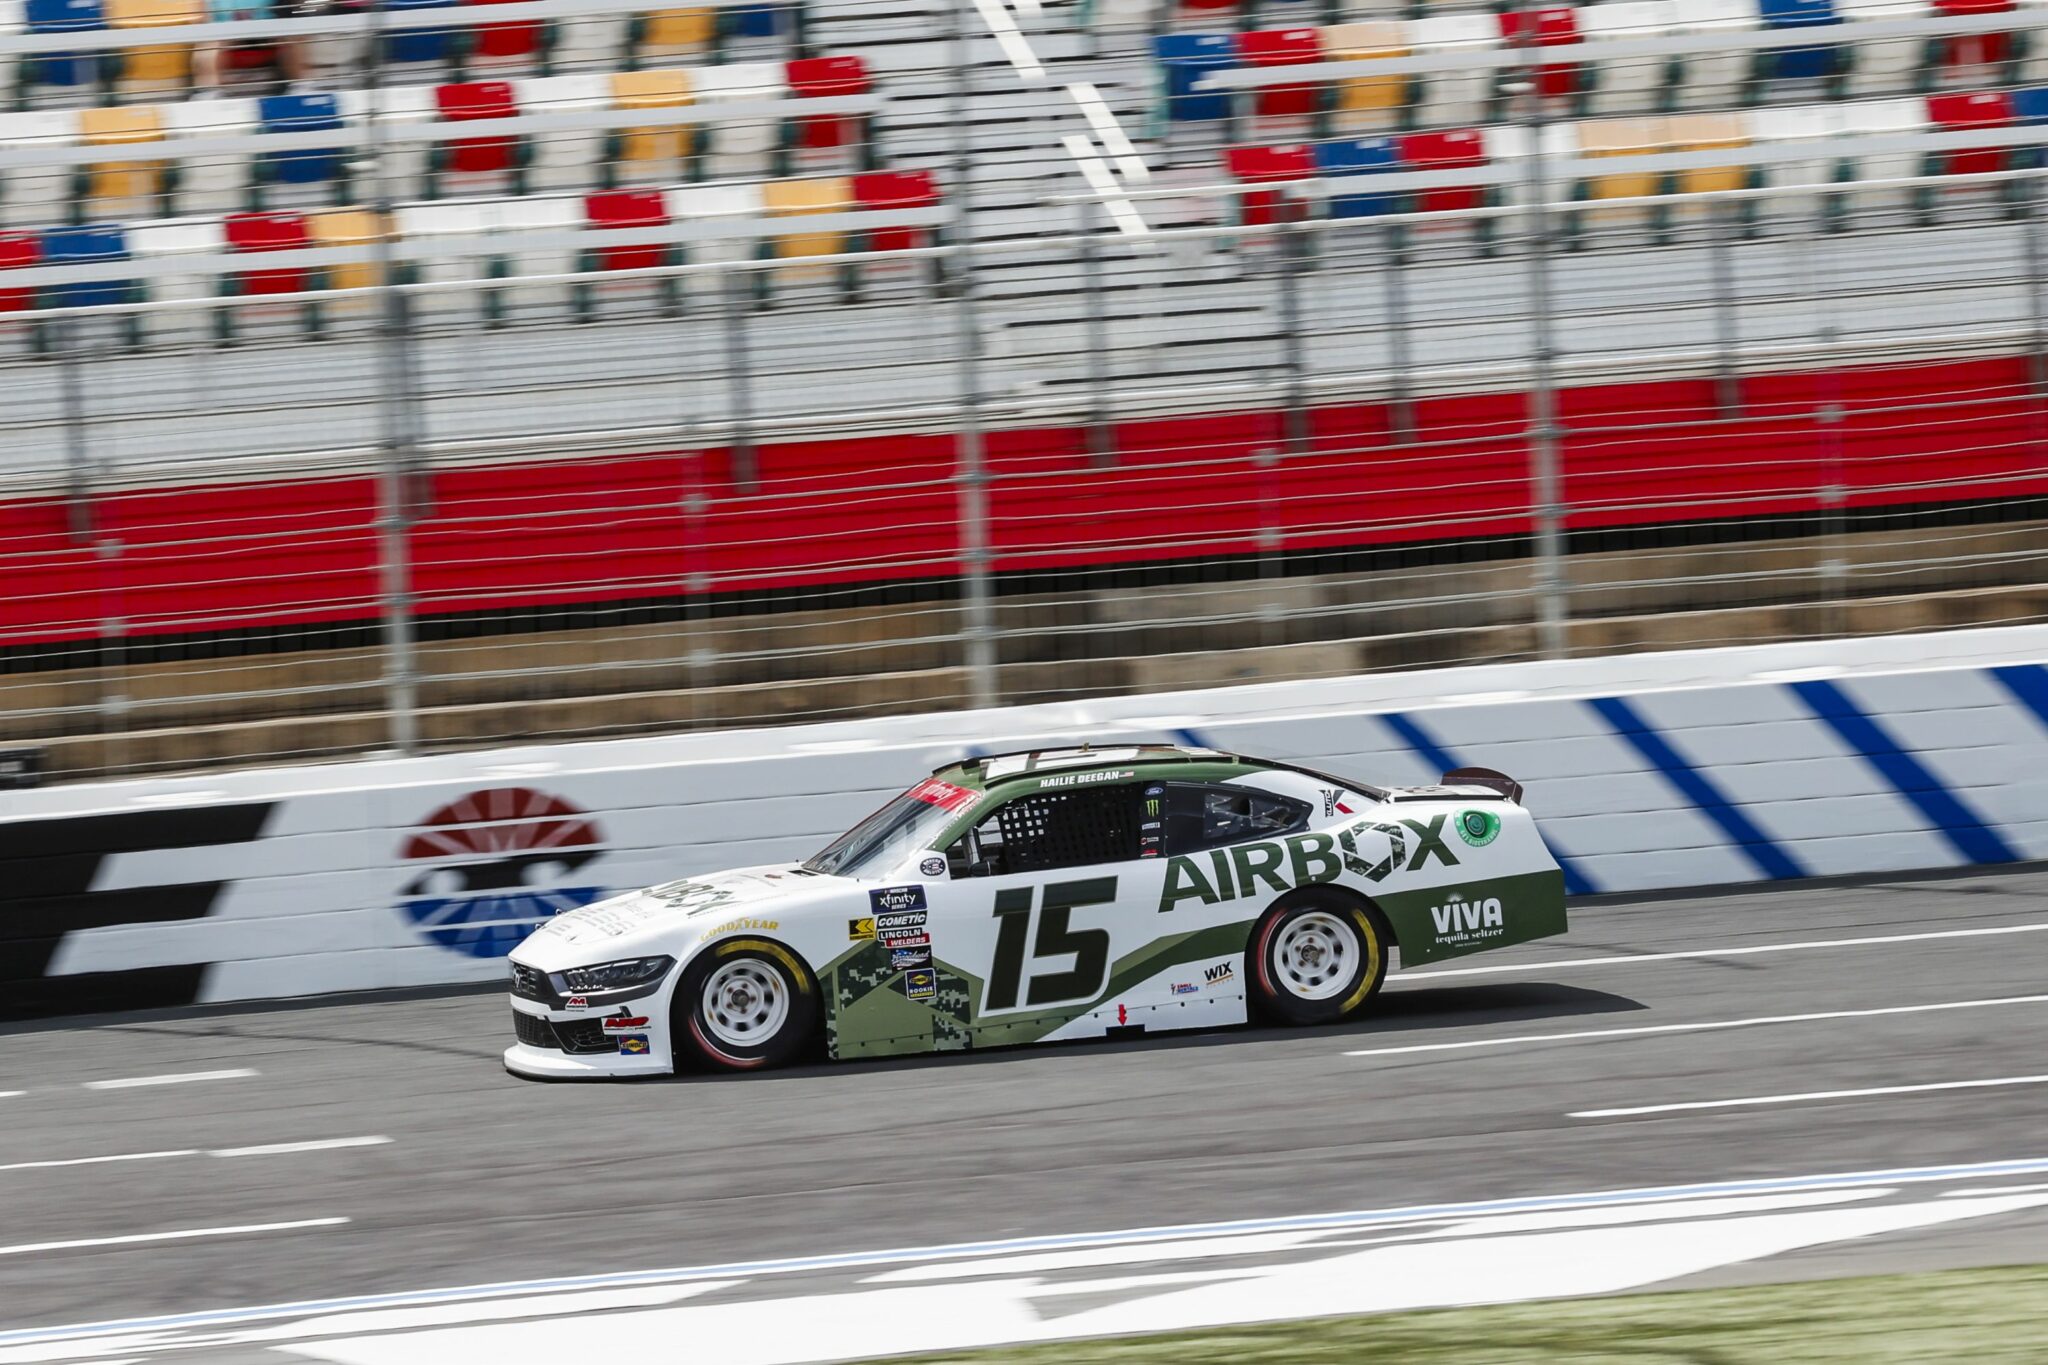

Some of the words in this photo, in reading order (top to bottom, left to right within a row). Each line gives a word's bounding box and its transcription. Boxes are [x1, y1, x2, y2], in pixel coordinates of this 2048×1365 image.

[1040, 775, 1075, 788] HAILIE
[1077, 771, 1120, 783] DEEGAN
[1158, 813, 1461, 913] AIRBOX
[880, 893, 916, 908] xfinity
[878, 913, 926, 926] COMETIC
[1430, 898, 1503, 934] VIVA
[700, 917, 779, 941] GOODYEAR
[880, 929, 921, 939] LINCOLN
[1435, 932, 1469, 945] tequila
[1471, 928, 1504, 939] seltzer
[890, 936, 926, 946] WELDERS
[985, 876, 1119, 1011] 15
[1204, 961, 1233, 981] WIX
[909, 986, 933, 994] ROOKIE
[621, 1041, 648, 1049] SUNOCO
